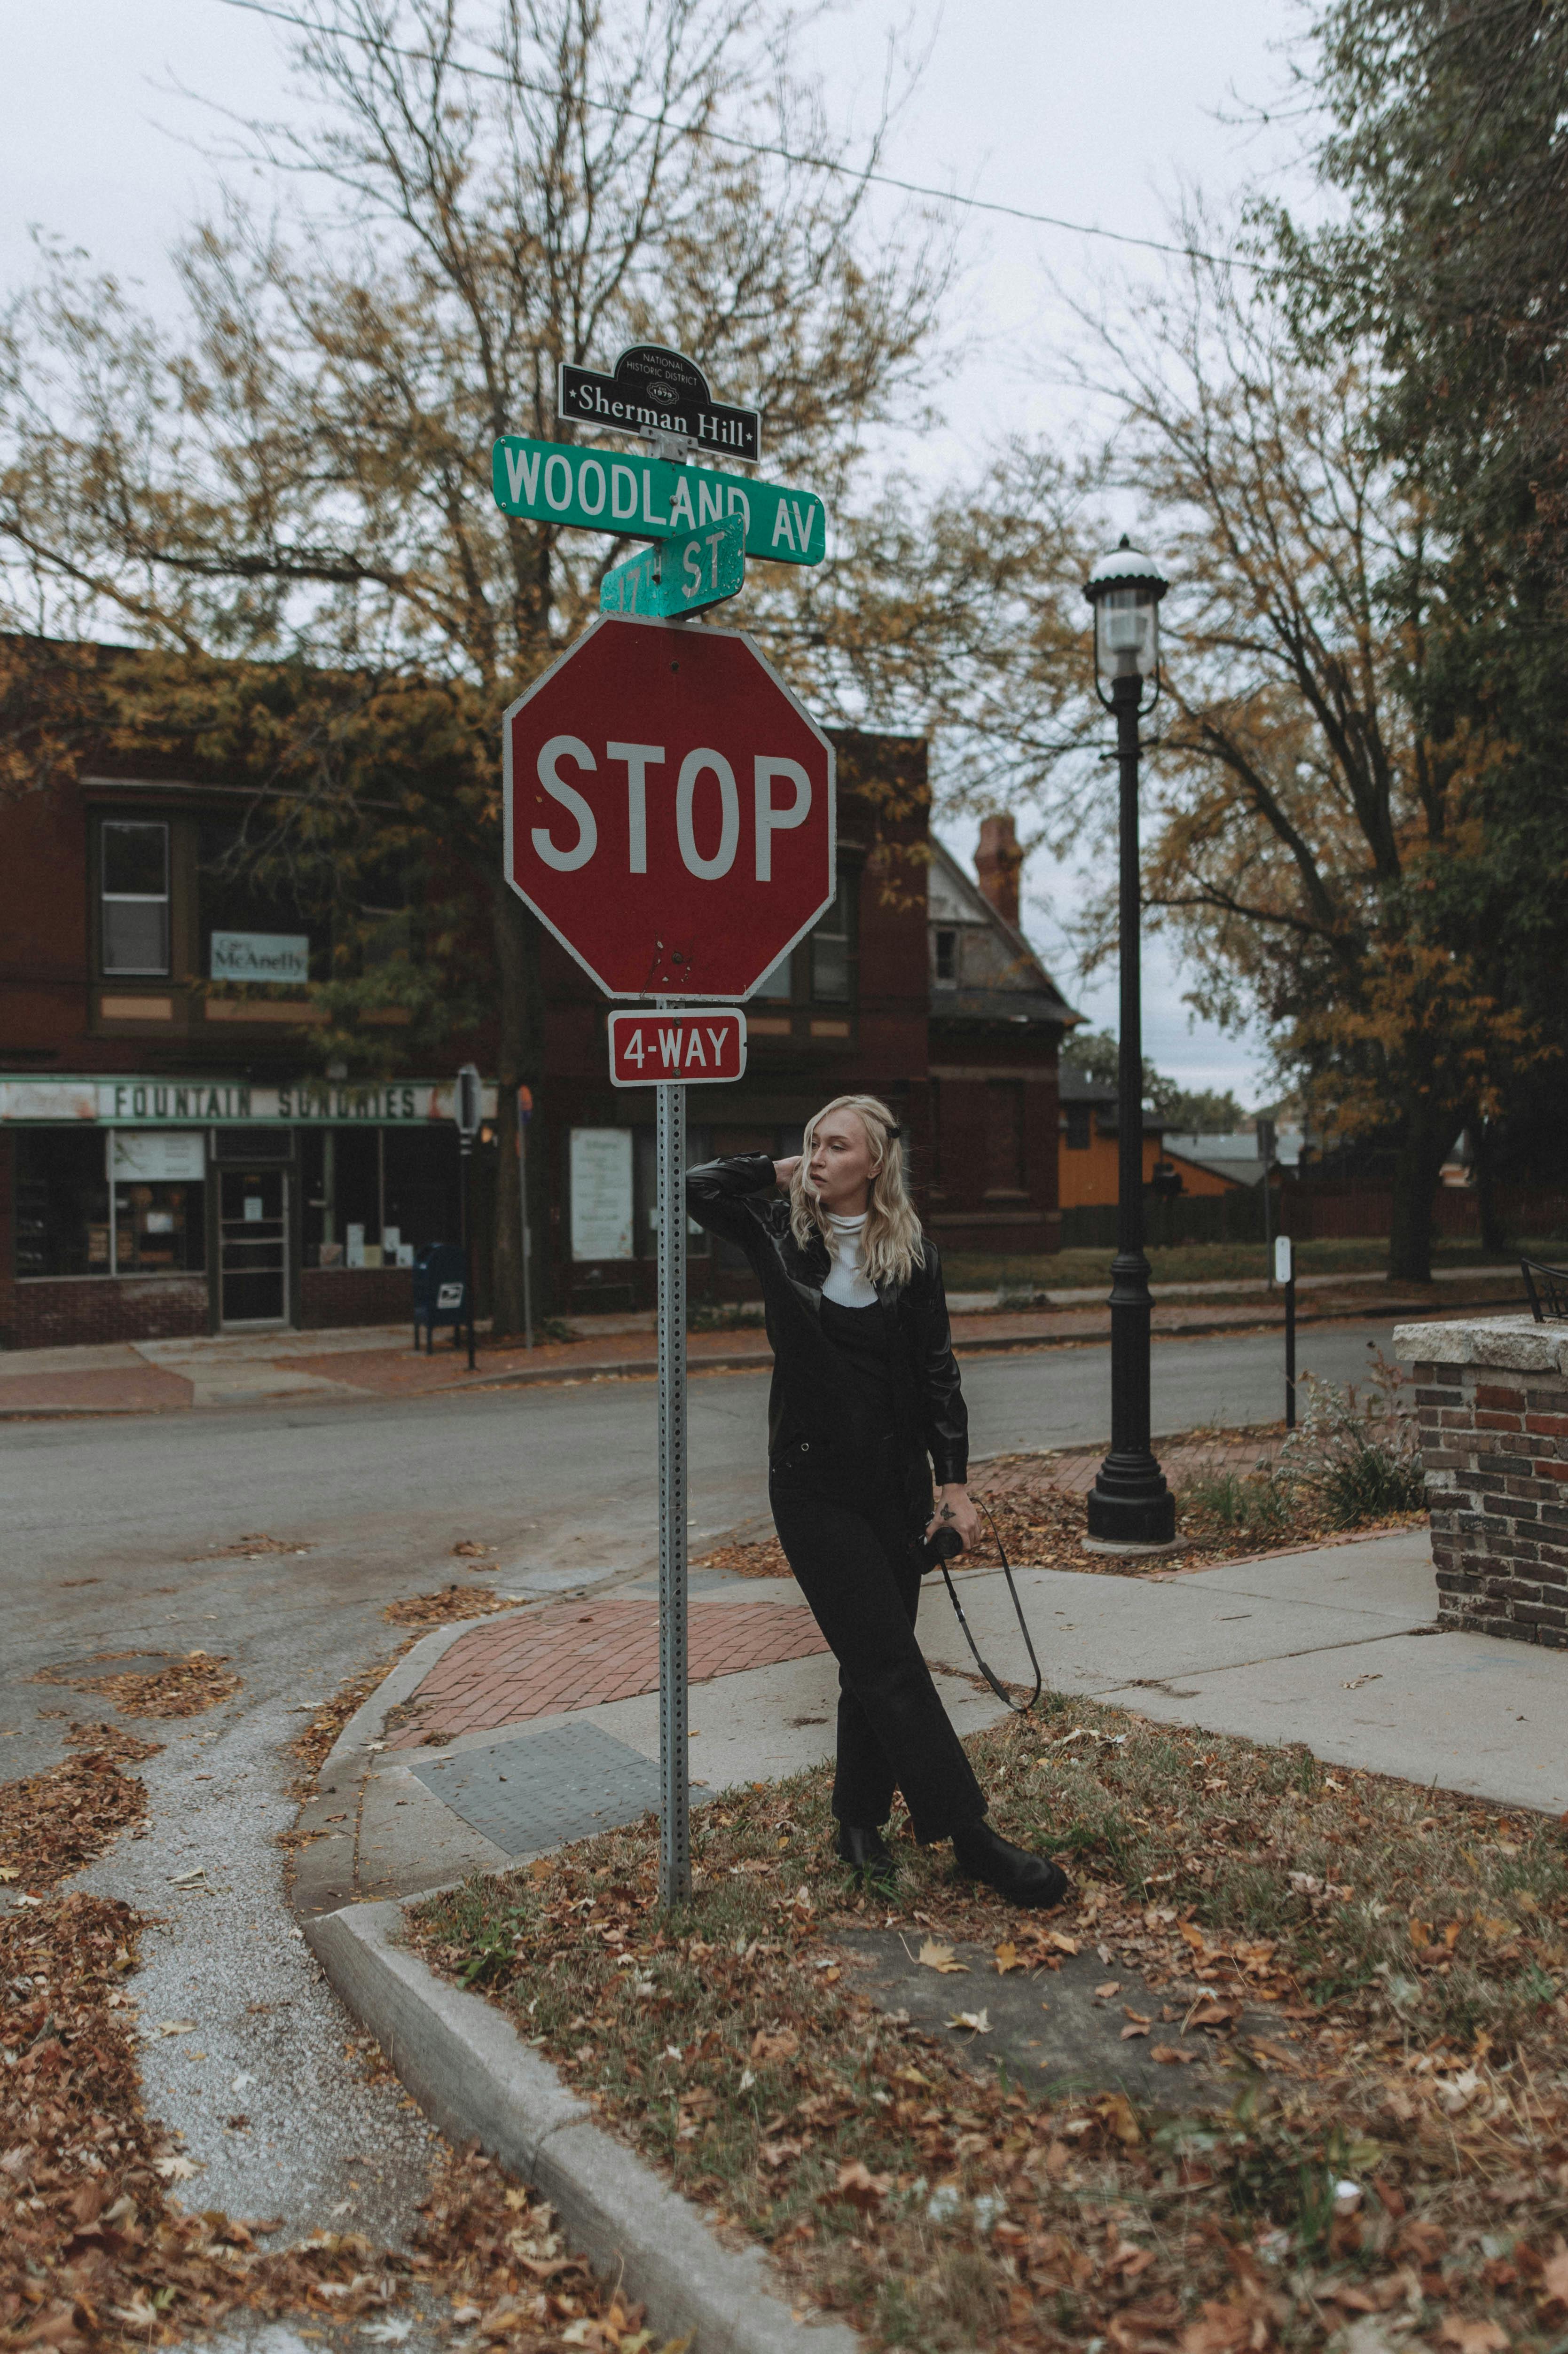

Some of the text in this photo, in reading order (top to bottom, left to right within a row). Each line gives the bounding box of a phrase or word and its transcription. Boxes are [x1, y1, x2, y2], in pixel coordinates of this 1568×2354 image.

[627, 361, 697, 386] HISTORIC DISTRICT
[643, 353, 684, 371] NATIONAL
[653, 389, 672, 398] 1979
[579, 384, 744, 447] Sherman Hill
[504, 447, 815, 553] WOODLAND AV
[619, 531, 724, 612] 17TH ST
[531, 735, 812, 882] STOP
[623, 1028, 729, 1068] 4-WAY
[114, 1086, 251, 1118] FOUNTAIN
